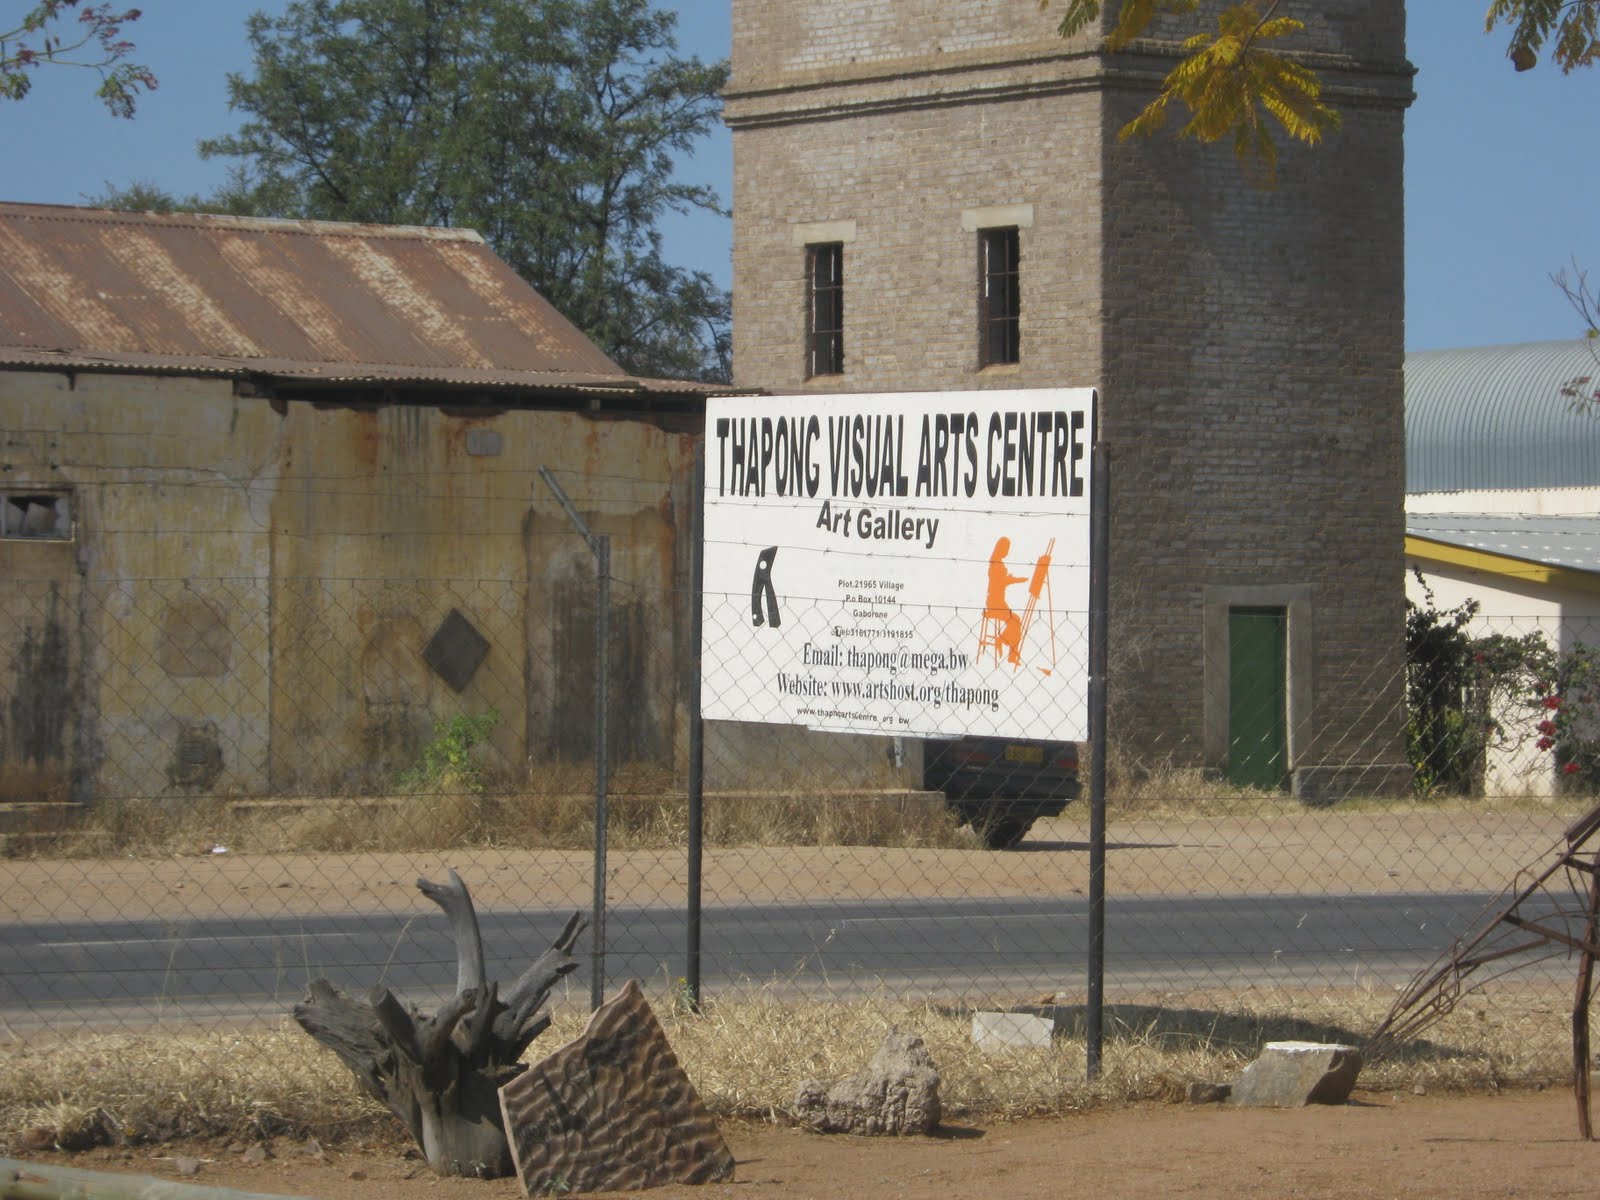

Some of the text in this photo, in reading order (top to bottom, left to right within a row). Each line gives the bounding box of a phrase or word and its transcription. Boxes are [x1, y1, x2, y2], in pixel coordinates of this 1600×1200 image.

[717, 411, 1084, 497] THAPONG VISUAL ARTS CENTRE
[816, 501, 939, 549] Art Gallery
[858, 595, 872, 603] Box
[874, 596, 896, 604] 10144
[879, 581, 904, 591] Village
[853, 609, 888, 618] Gaborone
[803, 643, 968, 675] Email: thapong@mega.bw
[777, 672, 999, 711] Website: www.artshost.org/thapong
